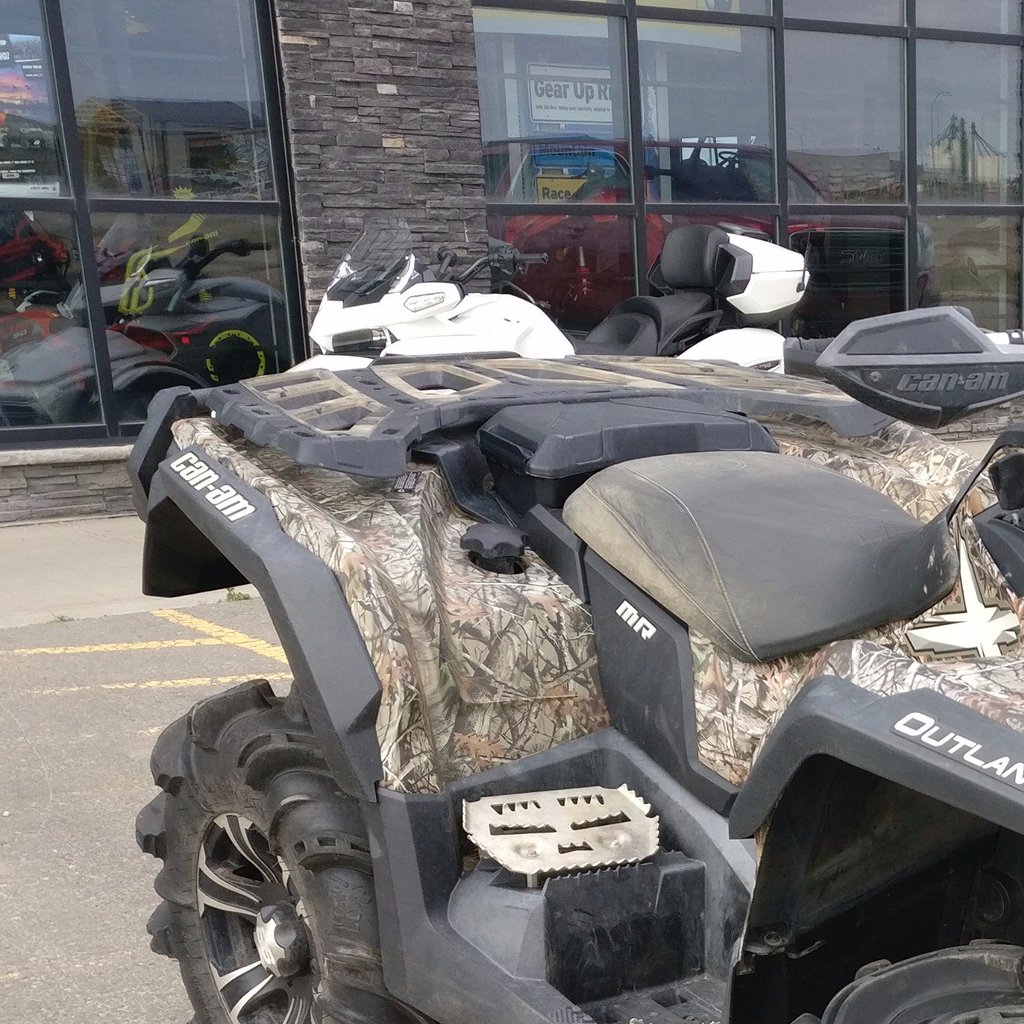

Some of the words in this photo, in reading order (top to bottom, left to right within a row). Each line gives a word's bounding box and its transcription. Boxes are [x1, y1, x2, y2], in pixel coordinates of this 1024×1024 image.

[534, 80, 570, 98] Gear
[573, 81, 595, 104] Up
[541, 187, 572, 200] Race
[896, 371, 1010, 392] can-am
[169, 452, 256, 523] can-am
